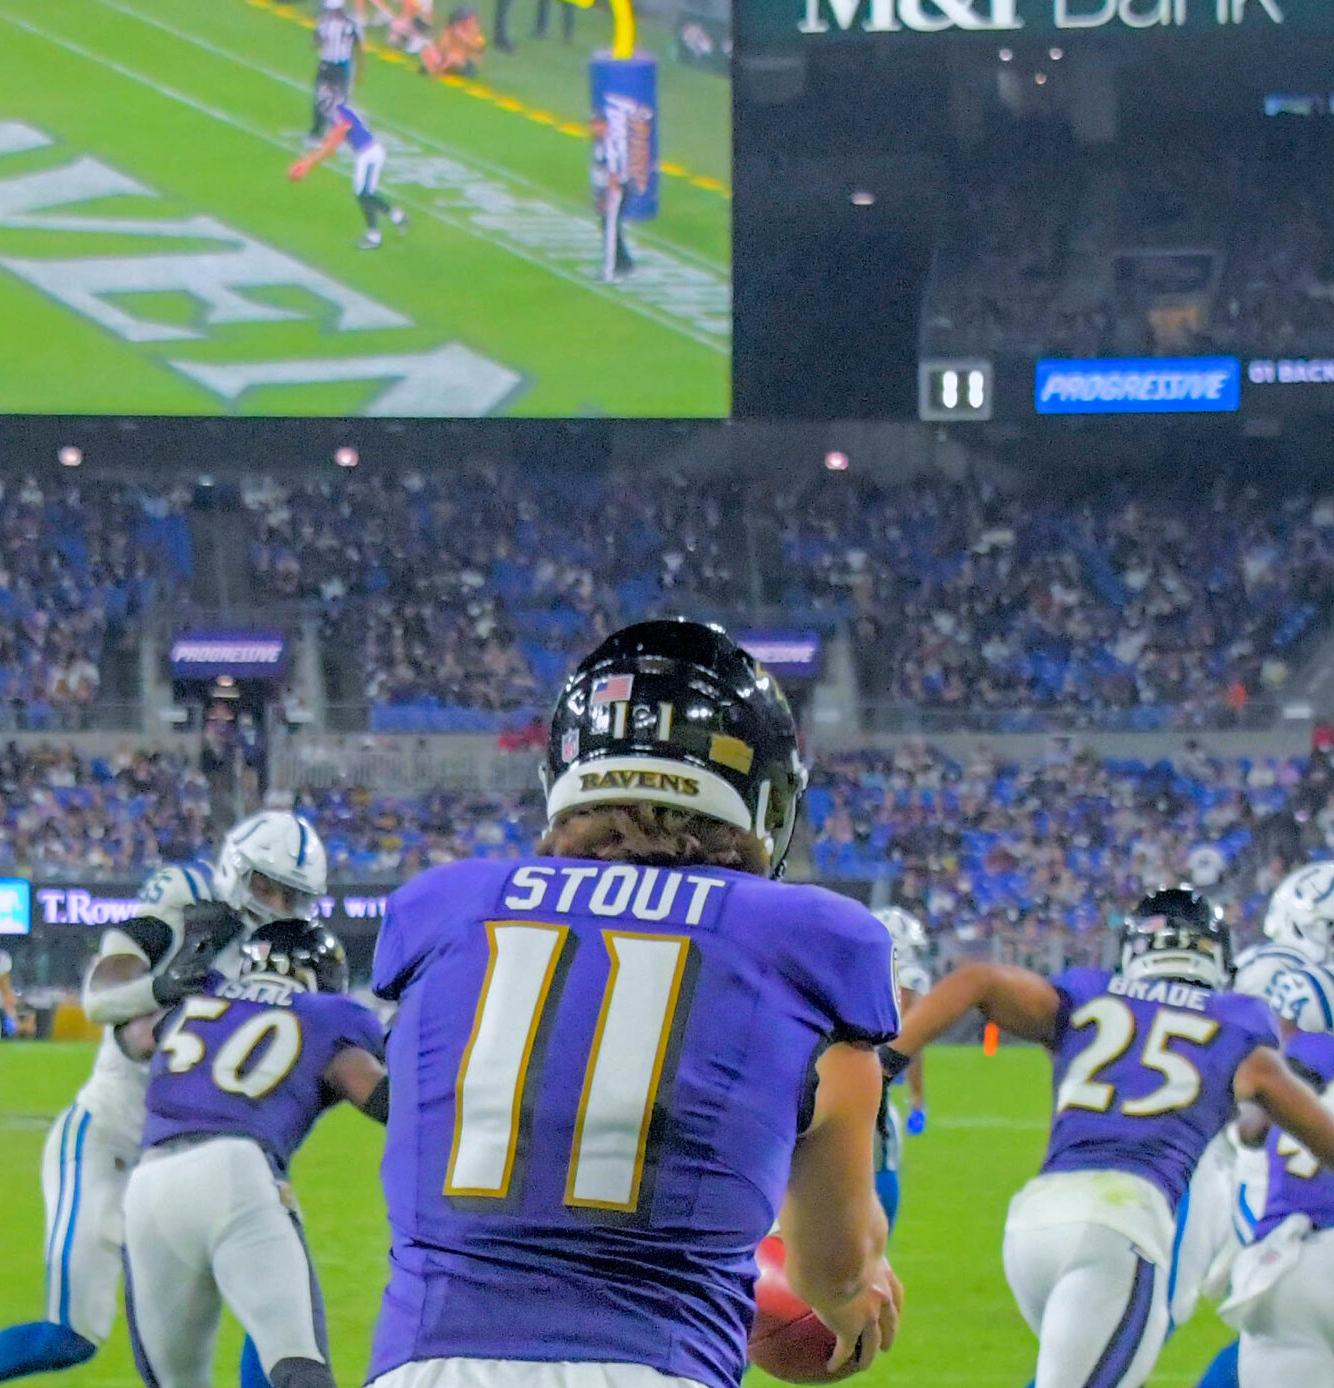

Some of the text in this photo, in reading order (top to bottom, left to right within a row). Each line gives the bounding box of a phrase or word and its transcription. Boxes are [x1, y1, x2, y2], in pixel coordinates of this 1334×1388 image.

[1041, 371, 1229, 402] PROGRESSIVE
[579, 769, 701, 796] RAVENS
[504, 866, 726, 926] STOUT
[1106, 973, 1212, 1012] BRADE
[162, 996, 303, 1099] 50
[443, 920, 691, 1212] 11
[1055, 997, 1220, 1117] 25
